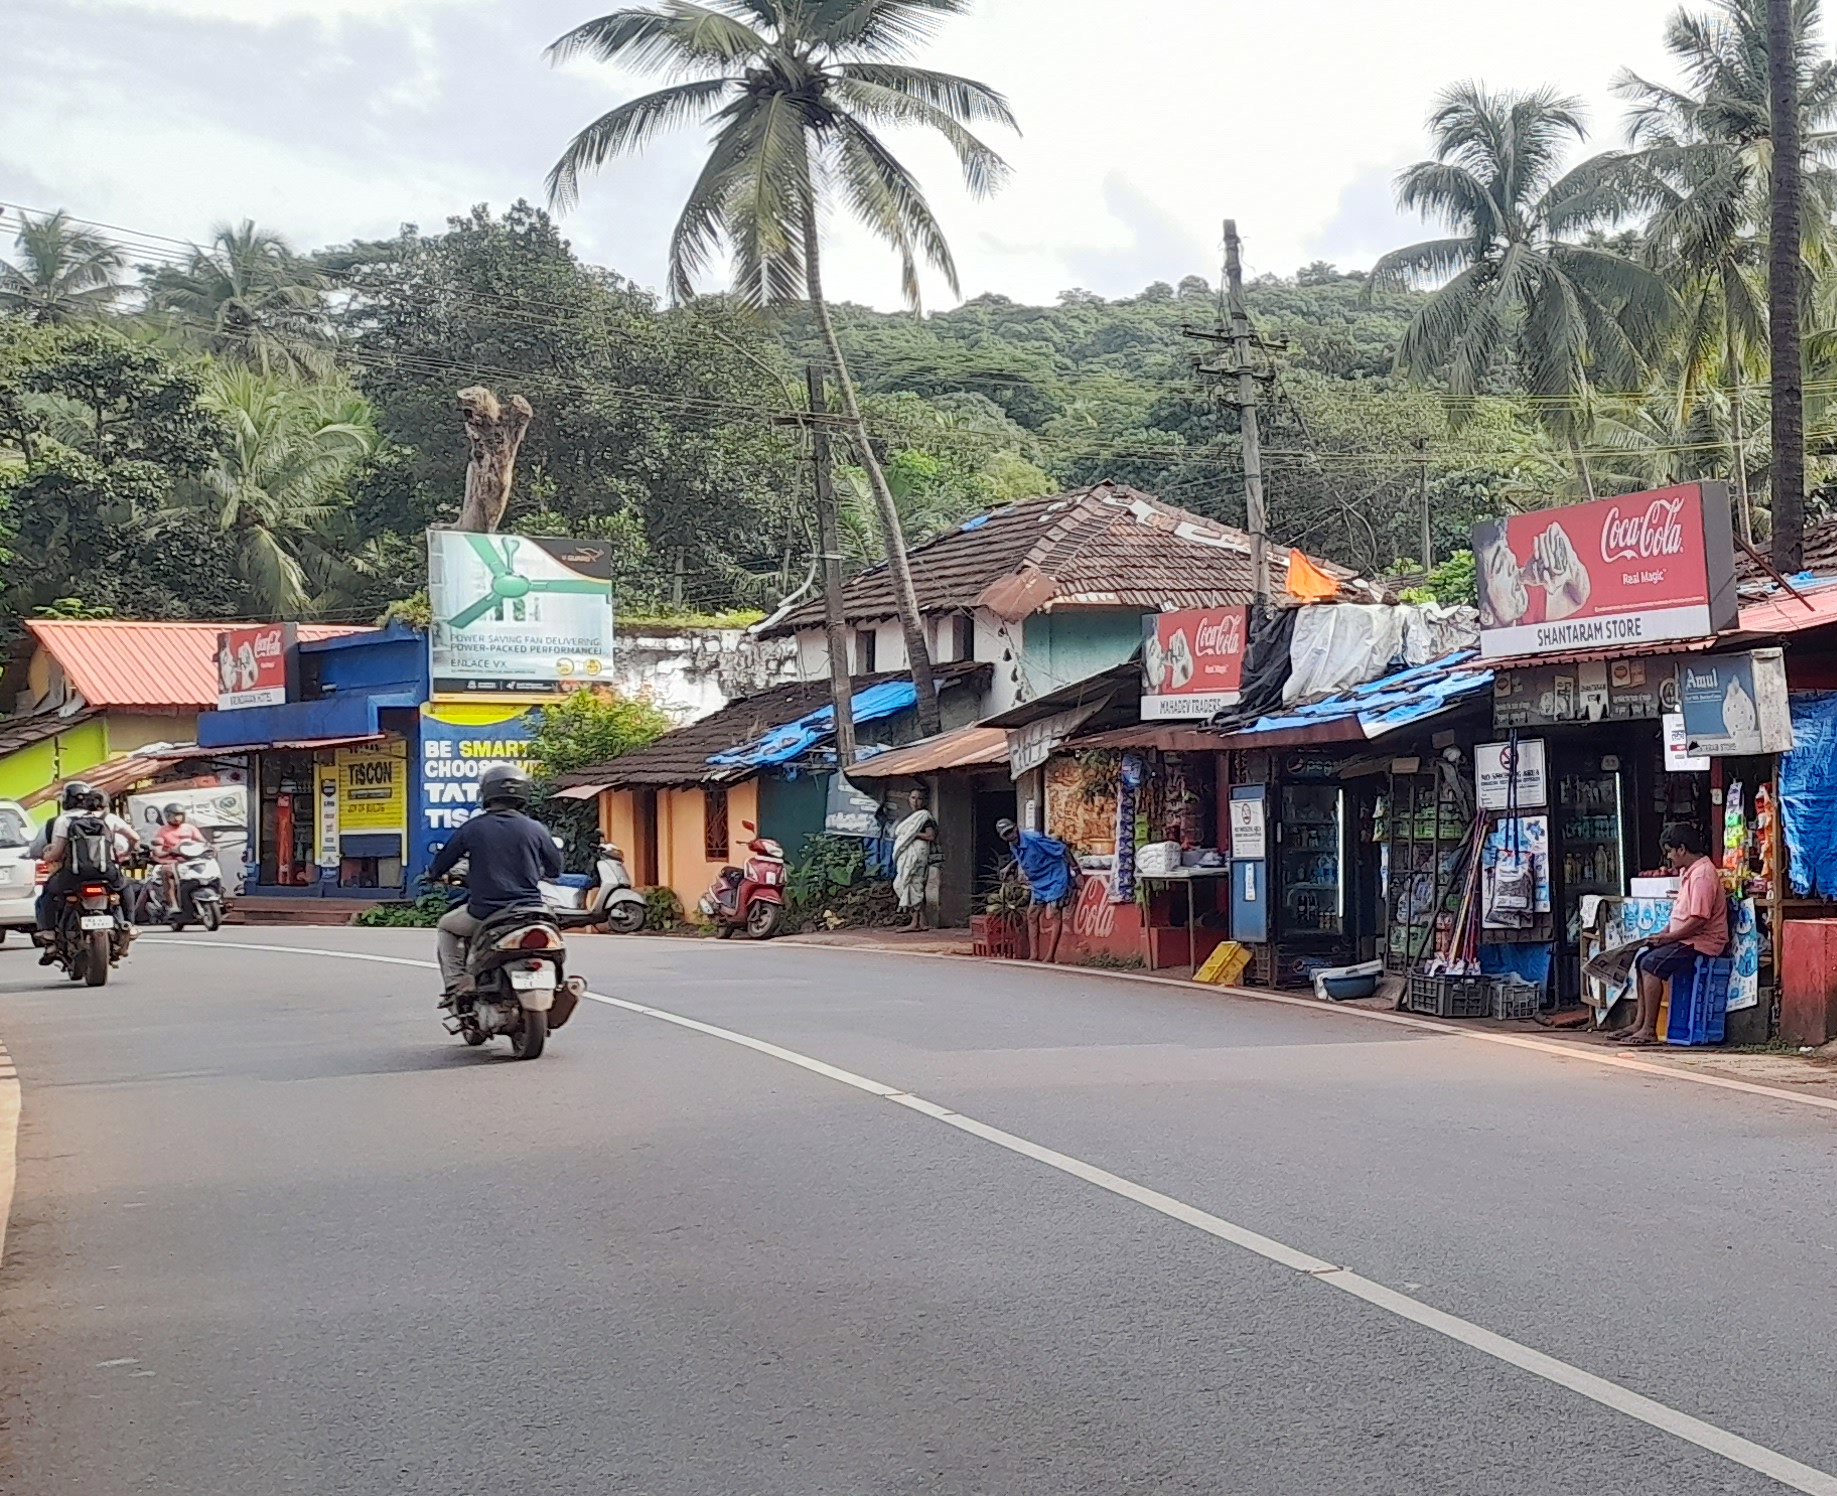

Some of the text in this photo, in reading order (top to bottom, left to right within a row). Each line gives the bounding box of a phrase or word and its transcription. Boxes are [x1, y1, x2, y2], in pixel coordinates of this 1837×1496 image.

[1622, 573, 1640, 585] Real
[450, 634, 600, 646] POWER SAVING FAN DELIVERING
[1537, 617, 1642, 647] SHANTARAM STORE
[450, 643, 527, 653] POWER-PACKED
[1686, 668, 1718, 690] Amul
[424, 740, 452, 758] BE
[424, 760, 506, 778] CHOOS
[423, 782, 483, 803] TAT
